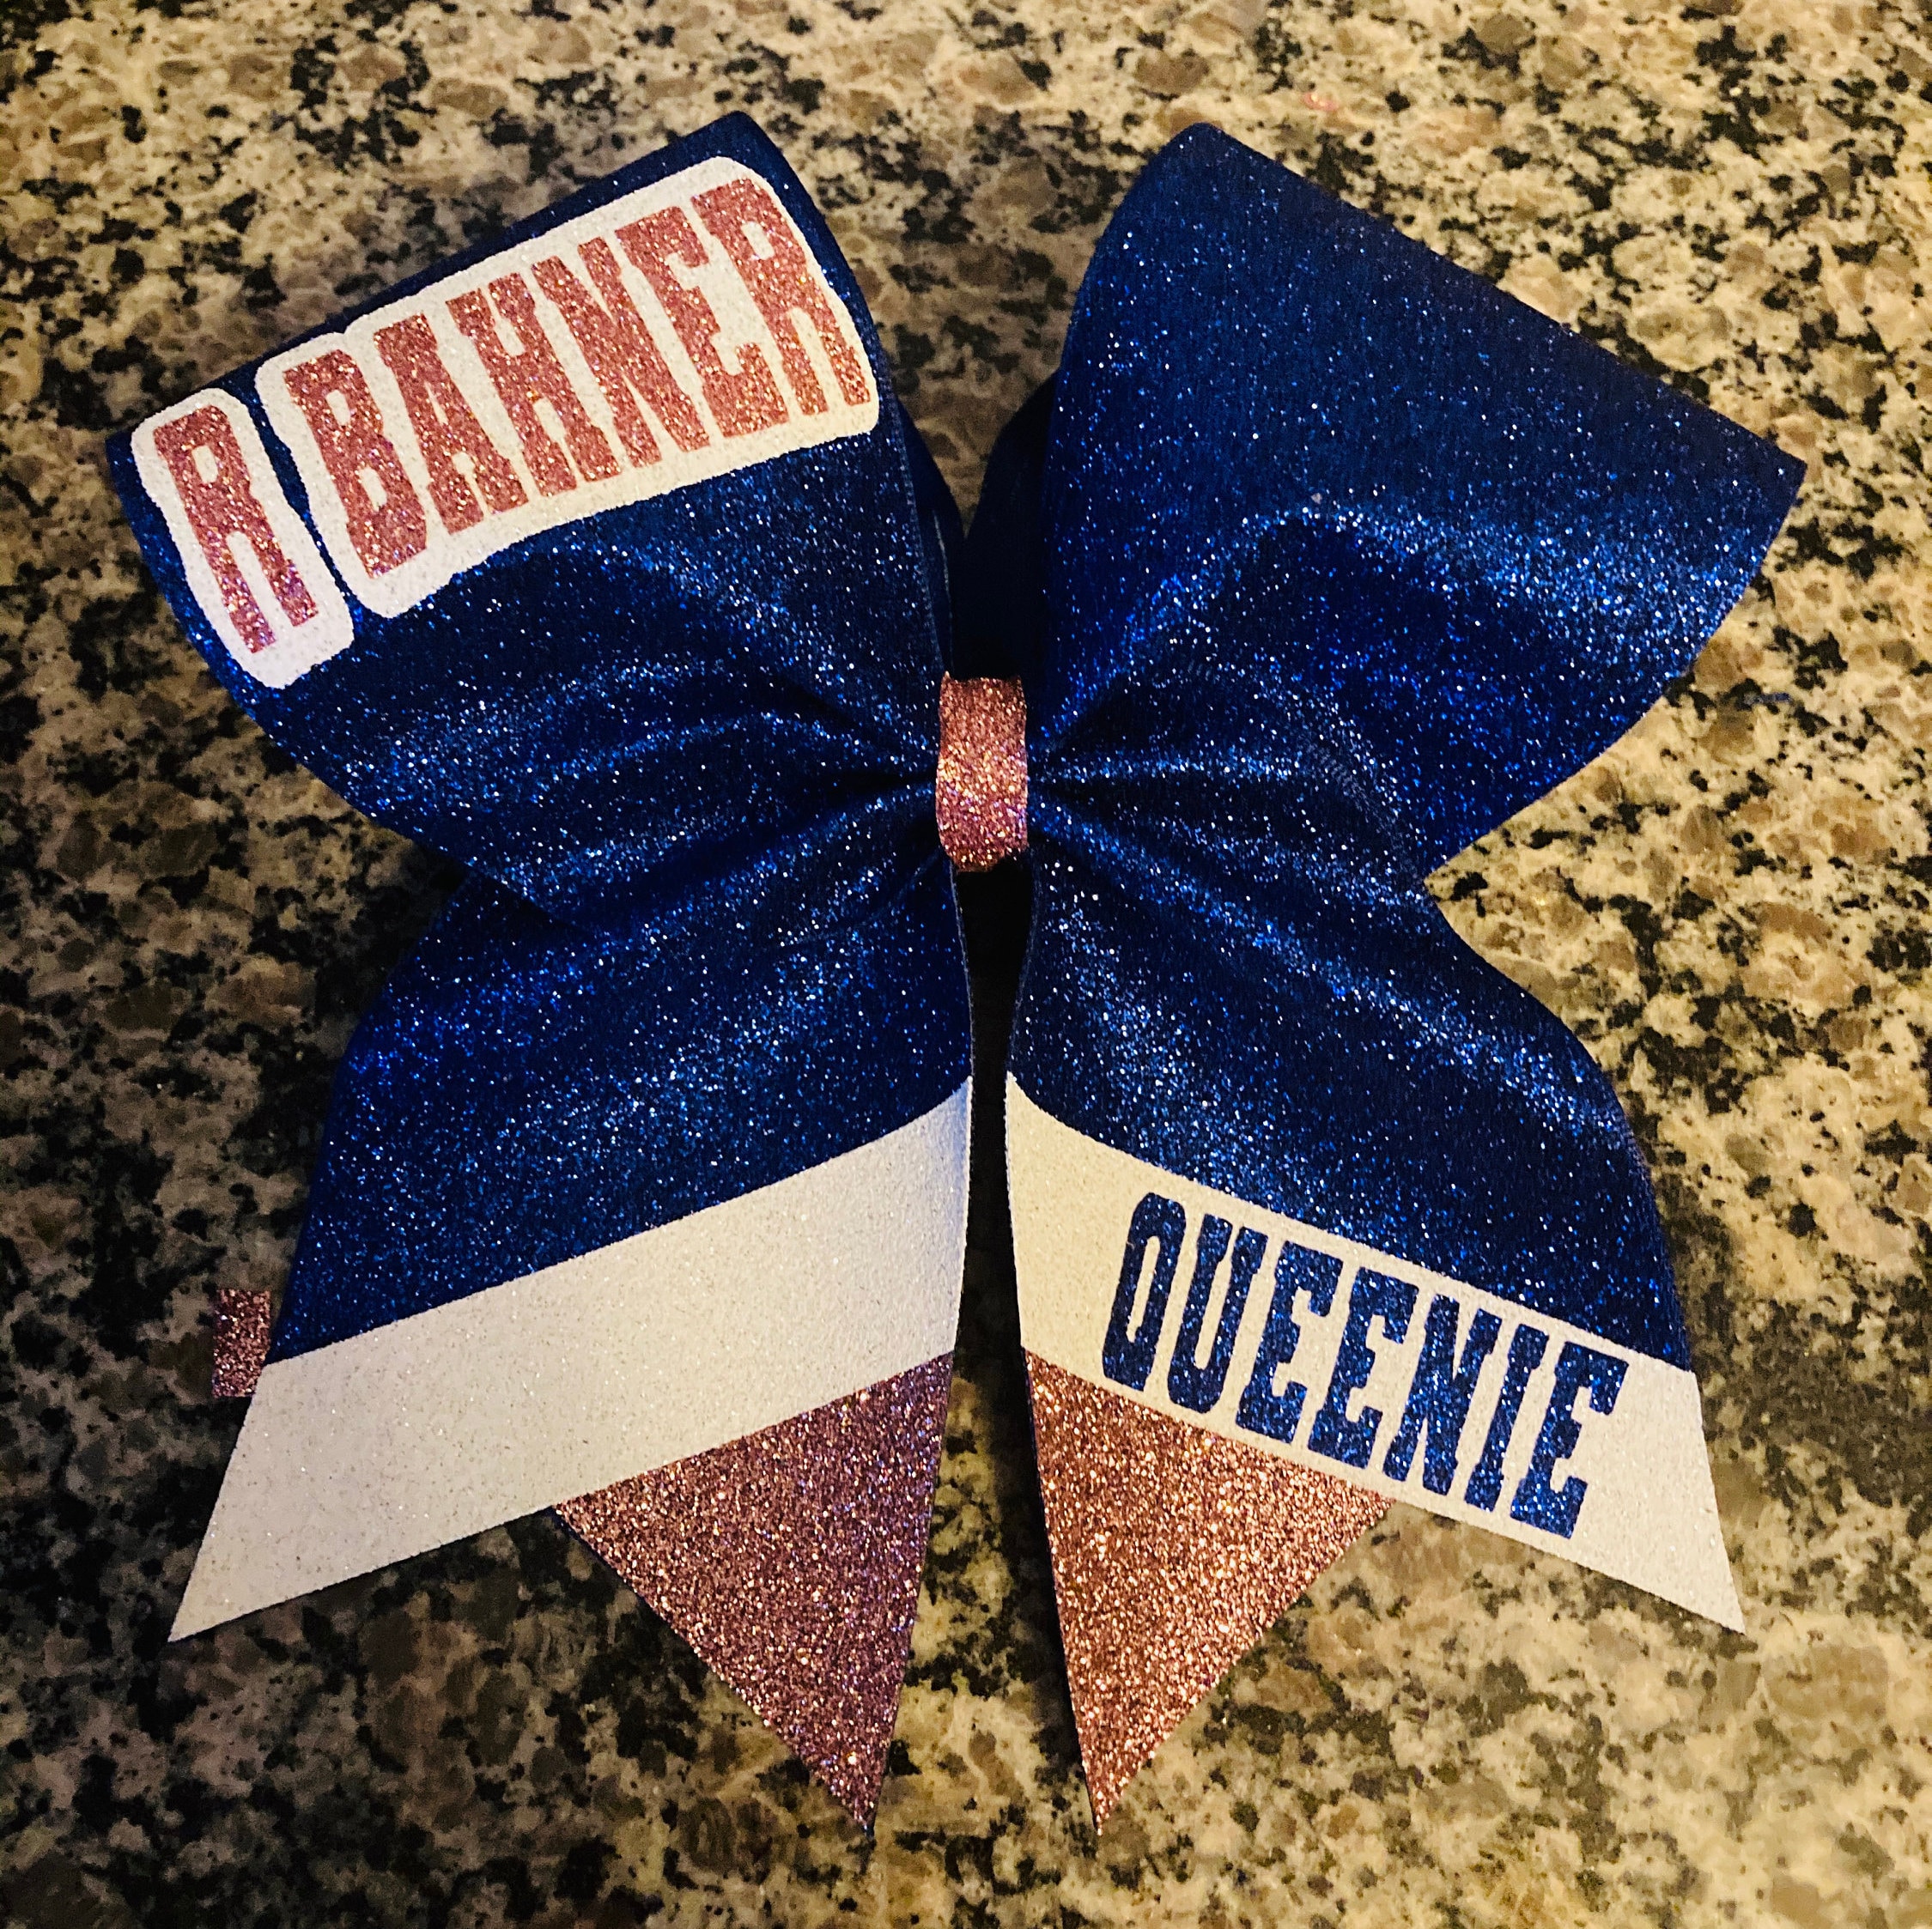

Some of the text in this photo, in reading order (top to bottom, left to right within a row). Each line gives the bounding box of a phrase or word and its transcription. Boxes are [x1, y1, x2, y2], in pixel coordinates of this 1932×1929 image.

[153, 178, 871, 653] R BAHNER
[1102, 1192, 1628, 1539] QUEENIE
